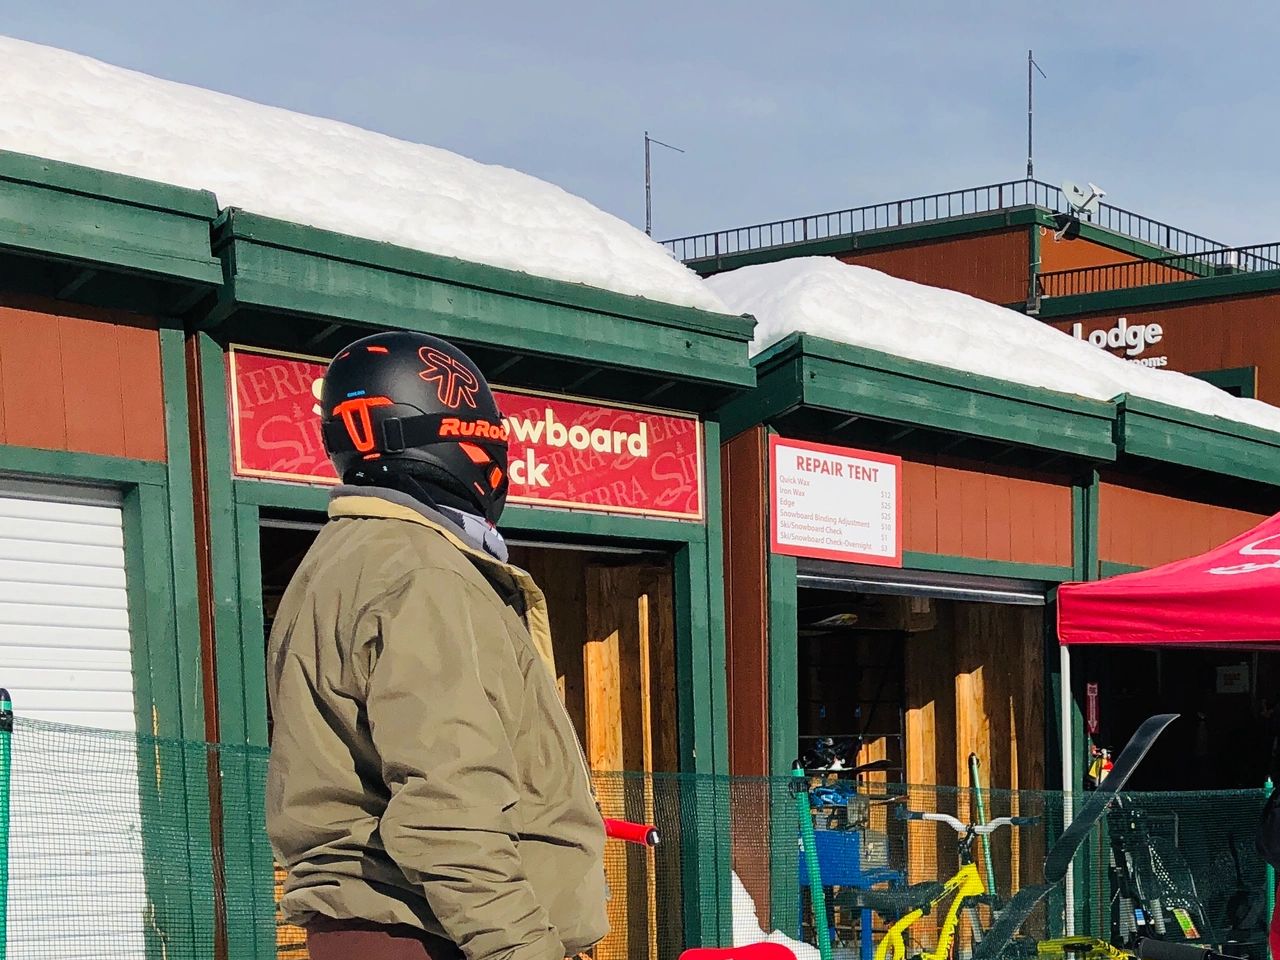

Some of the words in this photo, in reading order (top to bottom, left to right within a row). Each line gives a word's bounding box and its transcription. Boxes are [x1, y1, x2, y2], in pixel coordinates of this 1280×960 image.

[1073, 318, 1163, 355] Lodge
[796, 455, 843, 477] REPAIR
[847, 464, 879, 482] TENT
[779, 475, 797, 485] Quick
[798, 477, 810, 487] Wax
[779, 486, 792, 495] Iron
[793, 488, 805, 497] Wax
[779, 497, 795, 507] Edge
[779, 508, 814, 521] Snowboard
[814, 513, 837, 525] Binding
[838, 517, 870, 528] Adjustment
[780, 520, 825, 533] Ski/Snowboard
[825, 526, 843, 535] Check
[780, 531, 825, 544] Ski/Snowboard
